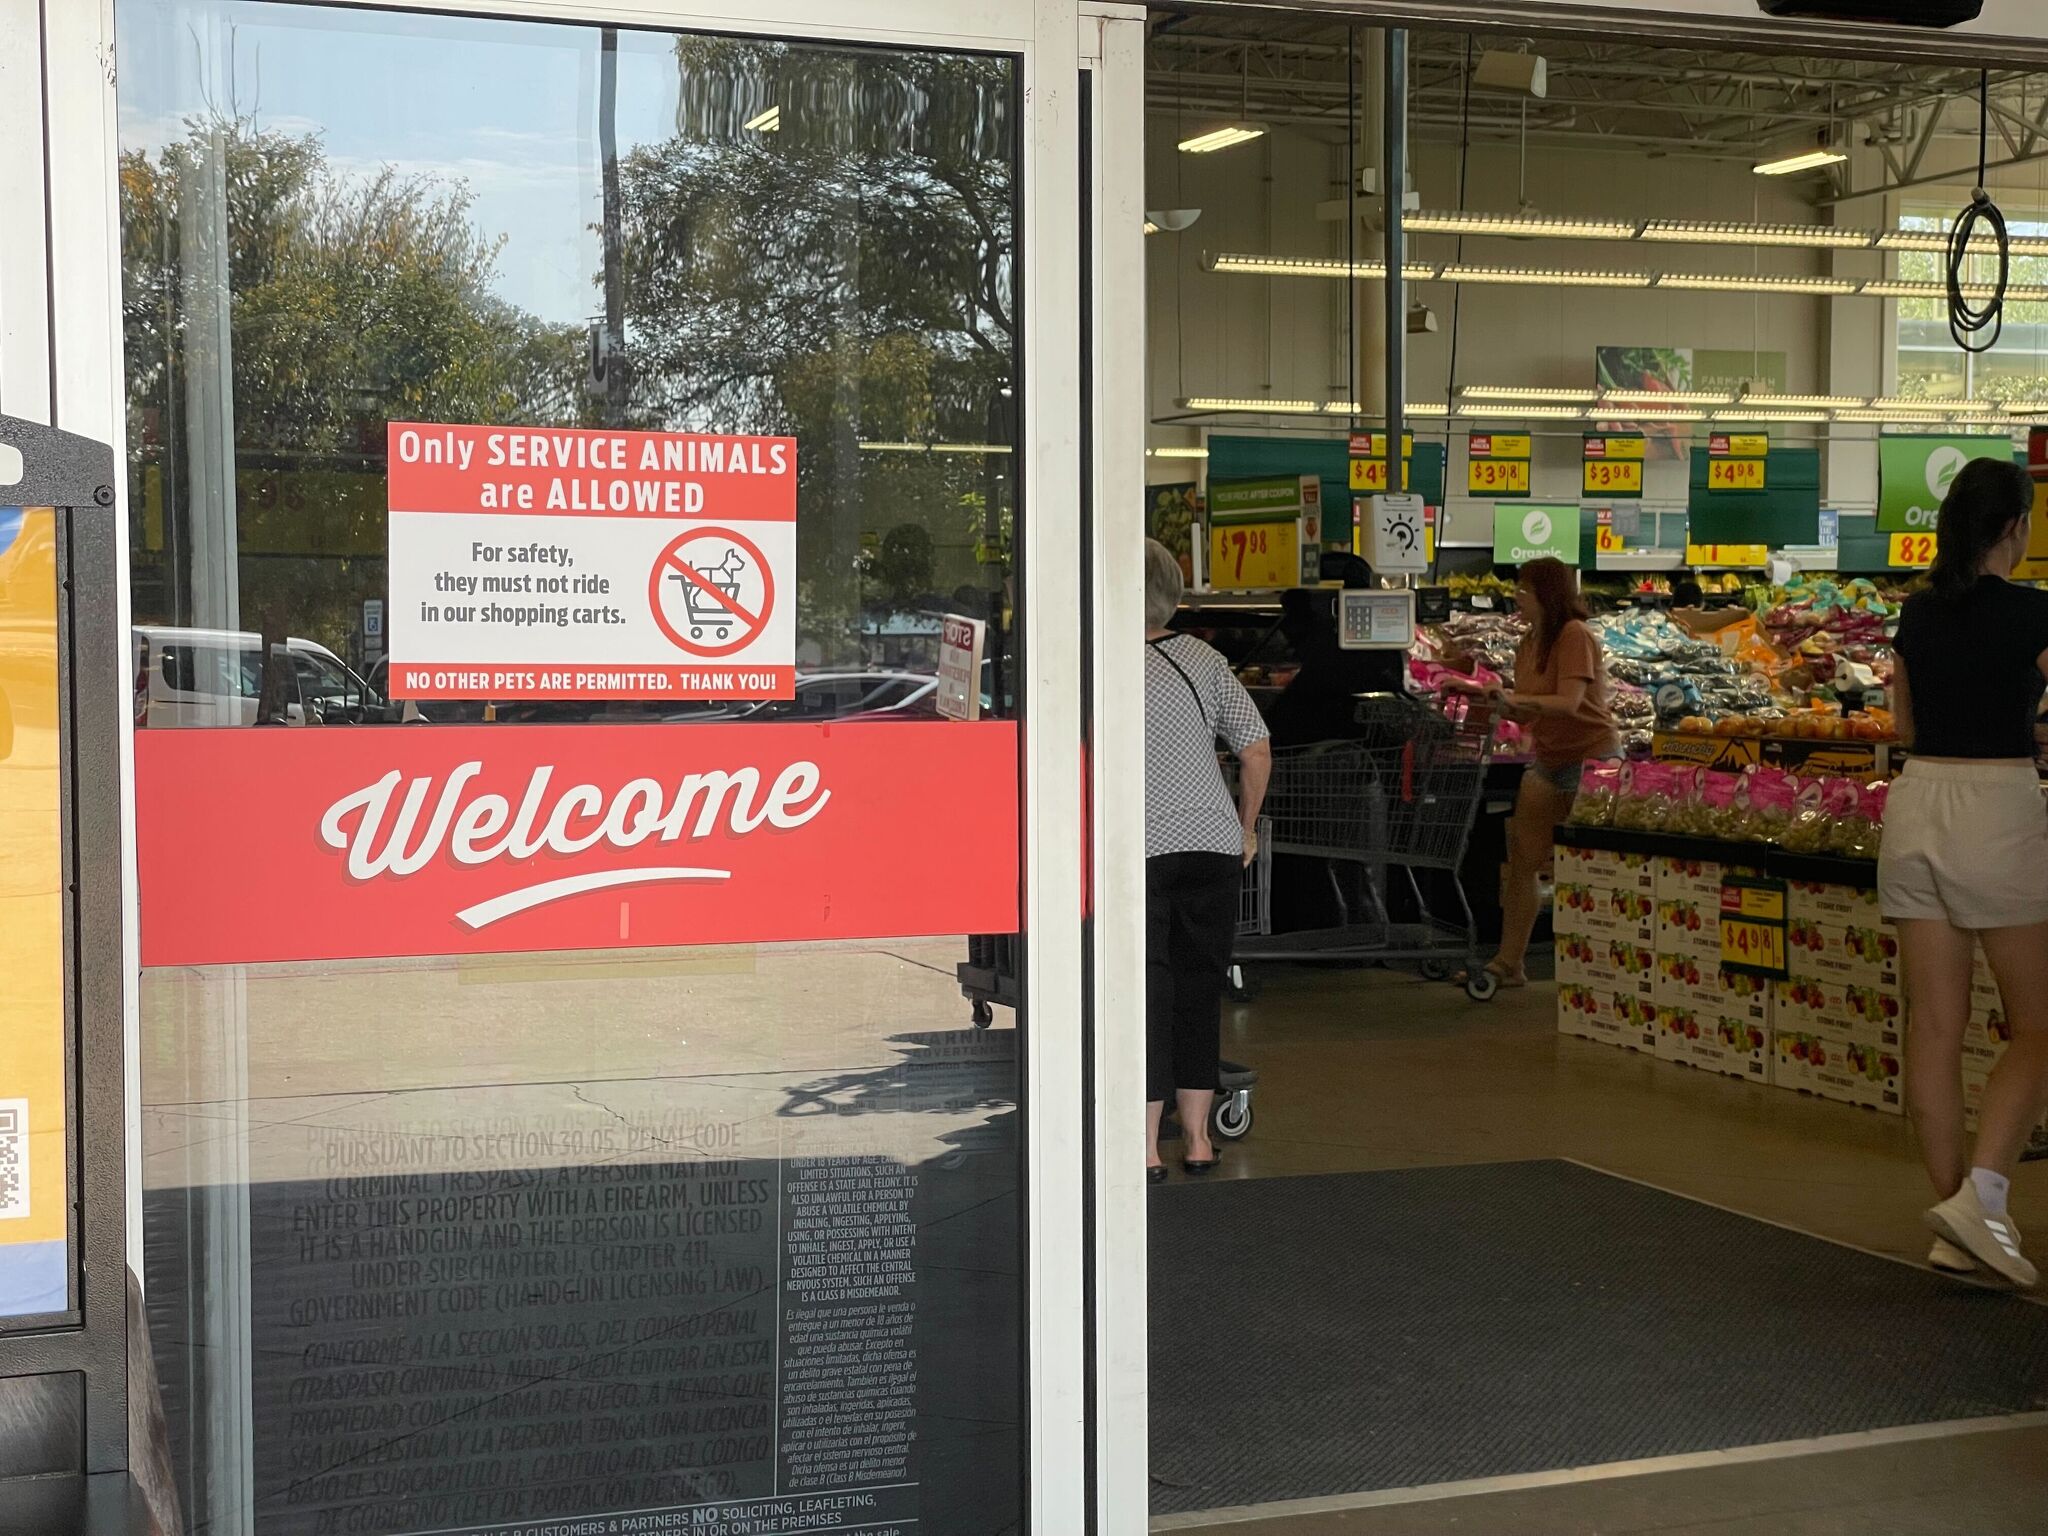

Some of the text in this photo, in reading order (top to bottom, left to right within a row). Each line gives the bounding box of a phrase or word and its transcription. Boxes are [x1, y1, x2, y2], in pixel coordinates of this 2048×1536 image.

[400, 431, 474, 470] Only
[487, 434, 628, 471] SERVICE
[639, 439, 788, 475] ANIMALS
[480, 478, 705, 513] are ALLOWED
[472, 542, 574, 567] For safety,
[434, 572, 610, 595] they must not ride
[420, 601, 626, 627] in our shopping carts.
[406, 672, 777, 690] NO OTHER PETS ARE PERMITTED. THANK YOU!
[320, 760, 832, 880] Welcome
[326, 1137, 436, 1168] PURSUANT
[440, 1136, 467, 1161] TO
[472, 1131, 553, 1160] SECTION
[694, 1122, 741, 1148] CODE
[577, 1164, 652, 1184] PERSON
[659, 1162, 695, 1180] MAY
[704, 1161, 738, 1177] NOT
[800, 1168, 828, 1180] LIMITED
[875, 1165, 894, 1176] SUCH
[895, 1165, 906, 1175] AN
[787, 1182, 818, 1193] OFFENSE
[836, 1179, 856, 1190] STATE
[857, 1178, 872, 1189] JAIL
[791, 1188, 903, 1205] ALSO UNLAWFUL FOR PERSON
[293, 1179, 769, 1232] ENTER THIS PROPERTY WITH A FIREARM, UNLESS
[796, 1201, 908, 1217] ABUSE VOLATILE CHEMICAL BY
[794, 1213, 911, 1229] INHALING, INGESTING, APPLYING,
[300, 1209, 761, 1262] IT IS A HANDGUN AND THE PERSON IS LICENSED
[787, 1224, 917, 1242] USING, OR POSSESSING WITH INTENT
[799, 1237, 909, 1253] INHALE, INGEST, APPLY, OR USE
[352, 1260, 421, 1288] UNDER
[428, 1251, 558, 1283] SUBCHAPTER
[590, 1243, 676, 1272] CHAPTER
[793, 1249, 911, 1266] VOLATILE CHEMICAL MANNER
[791, 1261, 912, 1278] DESIGNED AFFECT THE CENTRAL
[787, 1279, 820, 1291] NERVOUS
[853, 1275, 872, 1286] SUCH
[874, 1275, 884, 1285] AN
[886, 1272, 916, 1284] OFFENSE
[290, 1289, 434, 1325] GOVERNMENT
[438, 1286, 487, 1314] CODE
[610, 1270, 706, 1301] LICENSING
[817, 1290, 838, 1301] CLASS
[526, 1494, 877, 1536] CUSTOMERS & PARTNERS NO SOLICITING, LEAFLETING,
[692, 1512, 842, 1536] IN OR ON THE PREMISES
